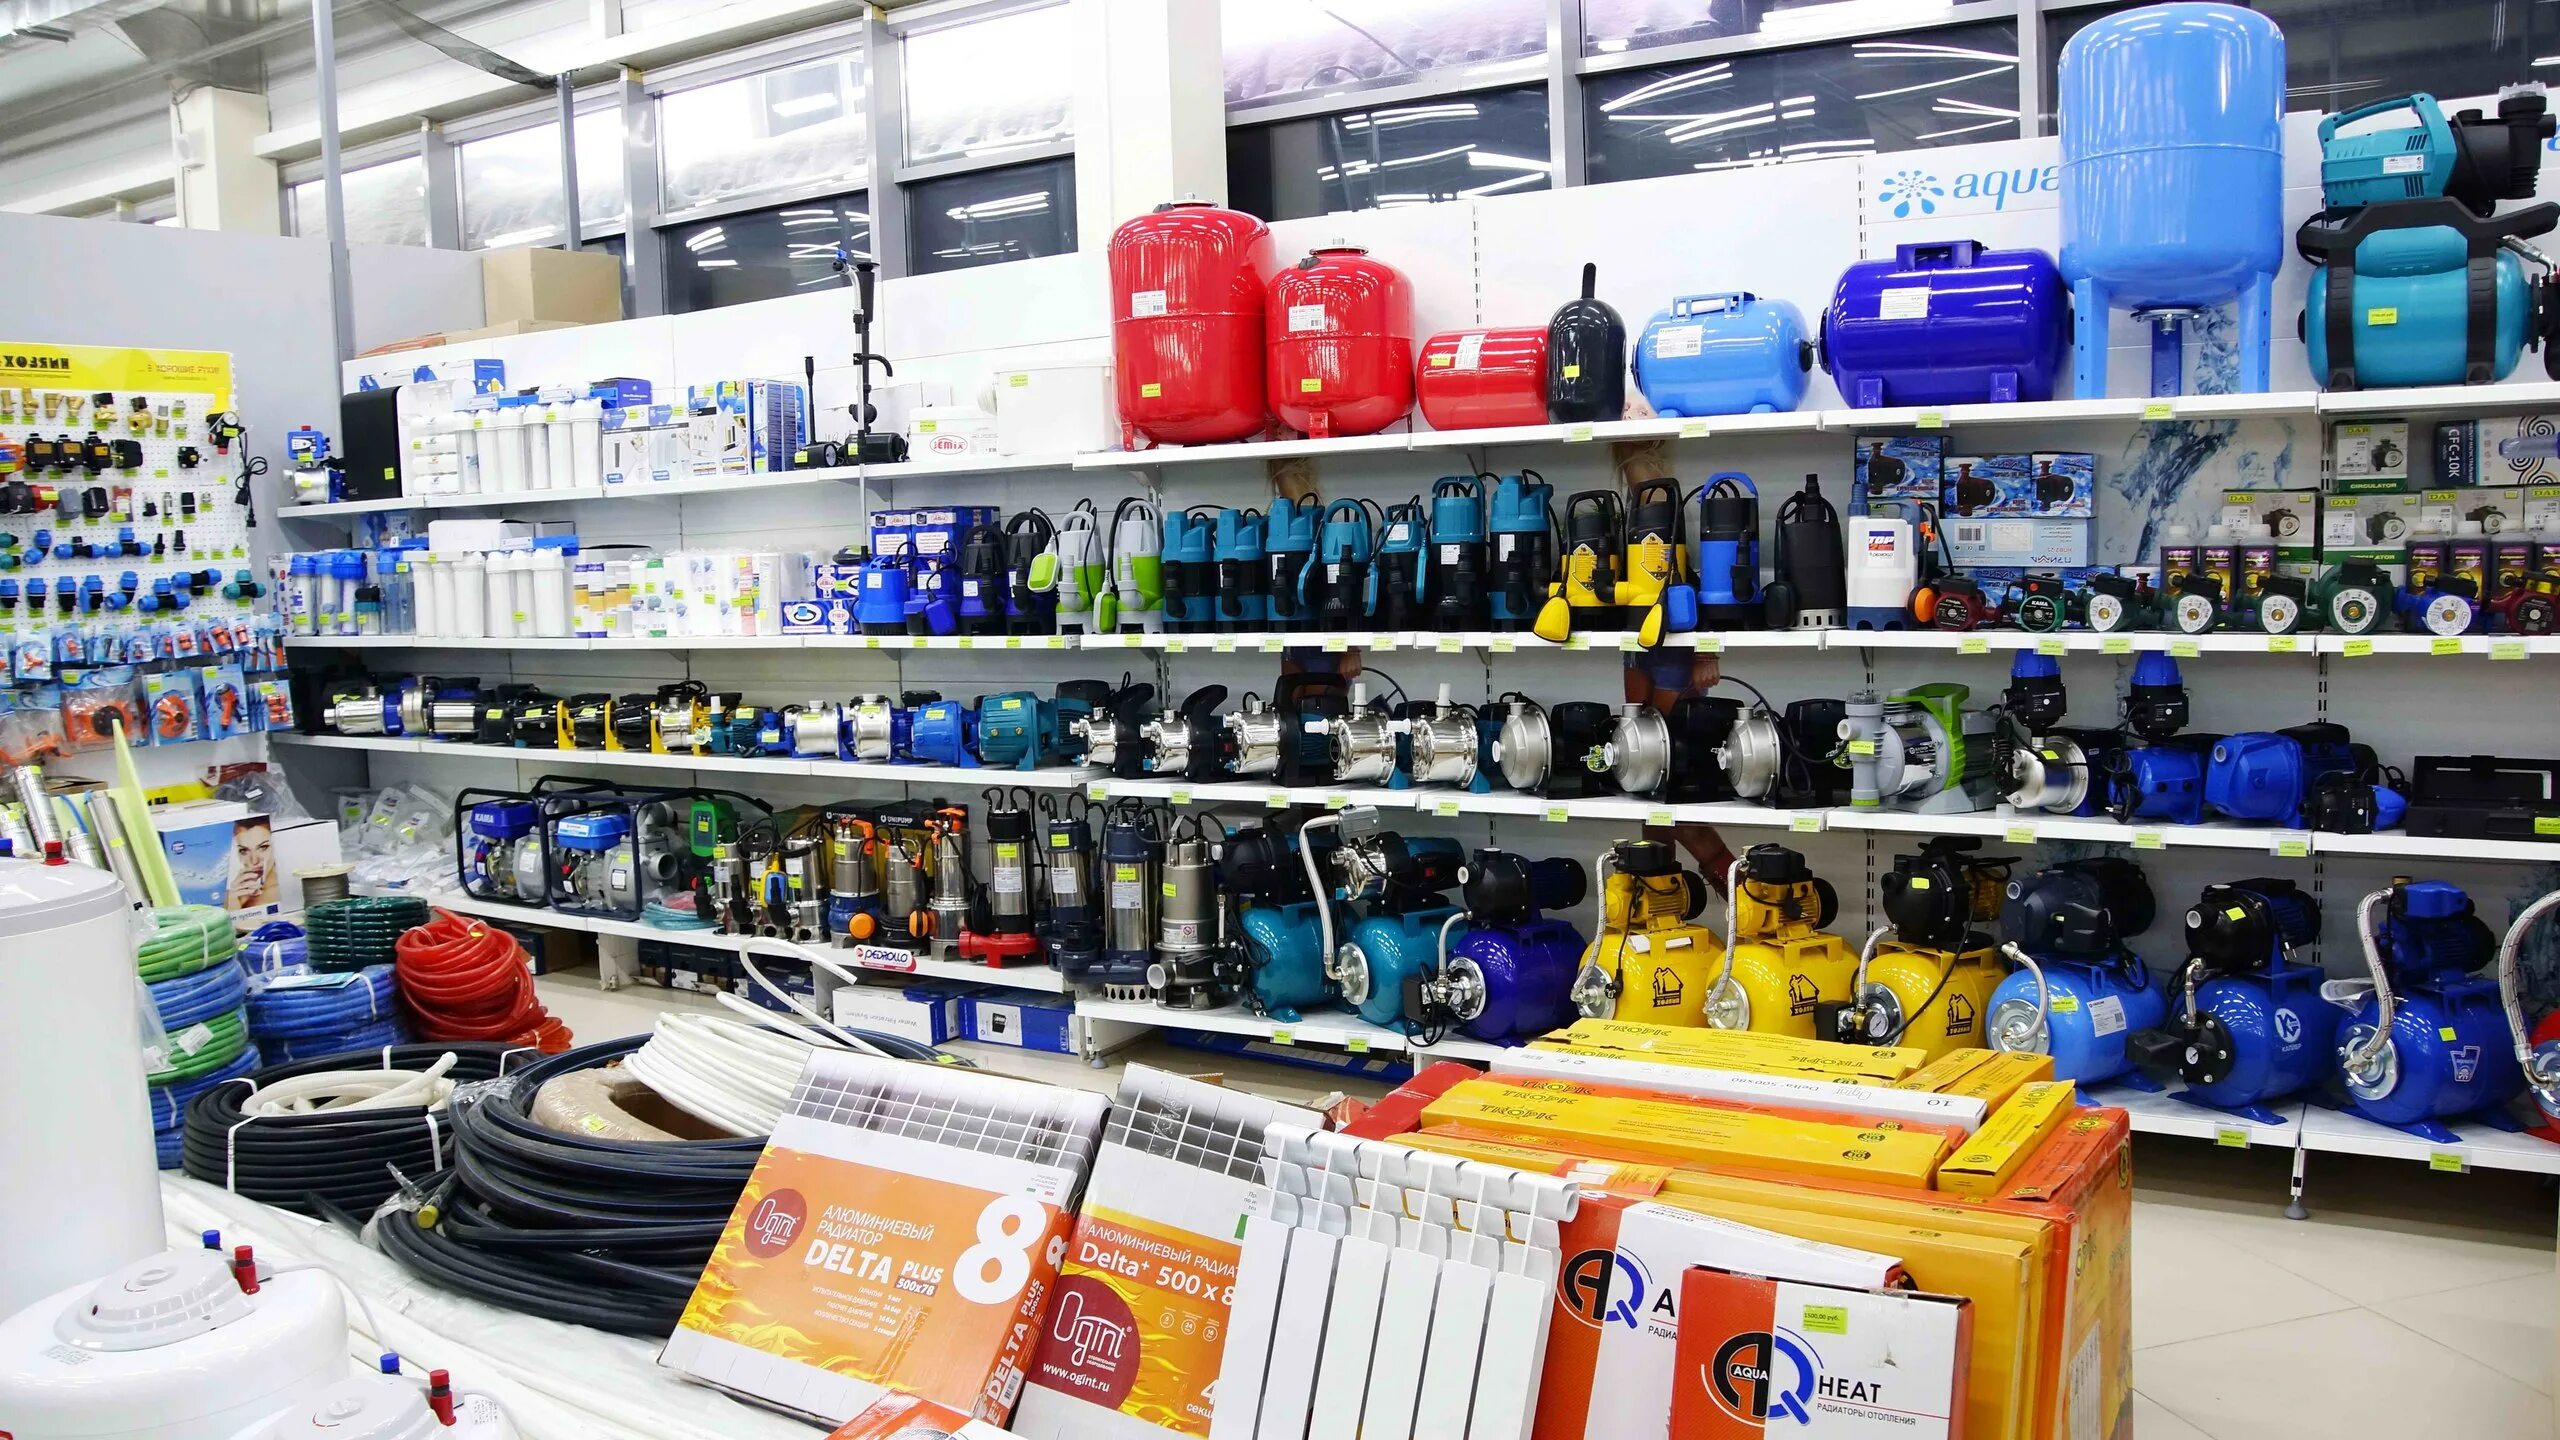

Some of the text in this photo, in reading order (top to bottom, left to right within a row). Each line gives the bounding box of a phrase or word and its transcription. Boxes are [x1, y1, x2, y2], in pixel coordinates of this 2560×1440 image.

[2448, 429, 2461, 478] CFC-10K
[2229, 495, 2254, 503] DAB
[474, 812, 494, 824] KAMA
[887, 816, 913, 824] UNIPUMP
[864, 949, 908, 963] PEDROLLO
[1602, 1023, 1672, 1037] TROPIC
[1556, 1047, 1627, 1060] TROPIC
[1787, 1055, 1865, 1068] TROPIC
[1502, 1089, 1579, 1105] TROPIC
[1521, 1080, 1596, 1096] TROPIC
[1480, 1105, 1558, 1122] TROPIC
[1926, 1098, 1952, 1107] 10
[754, 1198, 798, 1245] Ogint
[815, 1220, 884, 1246] РАДИАТОР
[822, 1205, 936, 1242] АЛЮМИНИЕВЫЙ
[951, 1194, 1047, 1305] 8
[1046, 1234, 1070, 1273] 8
[1086, 1224, 1192, 1264] АЛЮМИНИЕВЫЙ
[804, 1239, 893, 1284] DELTA
[900, 1261, 945, 1284] PLUS
[896, 1279, 936, 1296] 500x78
[1155, 1266, 1201, 1296] 500
[1020, 1278, 1040, 1317] PLUS
[1028, 1285, 1045, 1318] 500x78
[1804, 1312, 1826, 1320] 1500,00
[1054, 1290, 1127, 1367] Ogint
[987, 1320, 1029, 1400] DELTA
[1042, 1363, 1111, 1394] www.ogint.ru
[1733, 1365, 1768, 1381] AQUA
[1818, 1375, 1882, 1403] HEAT
[1816, 1403, 1916, 1426] РАДИАТОРЫ ОТОПЛЕНИЯ
